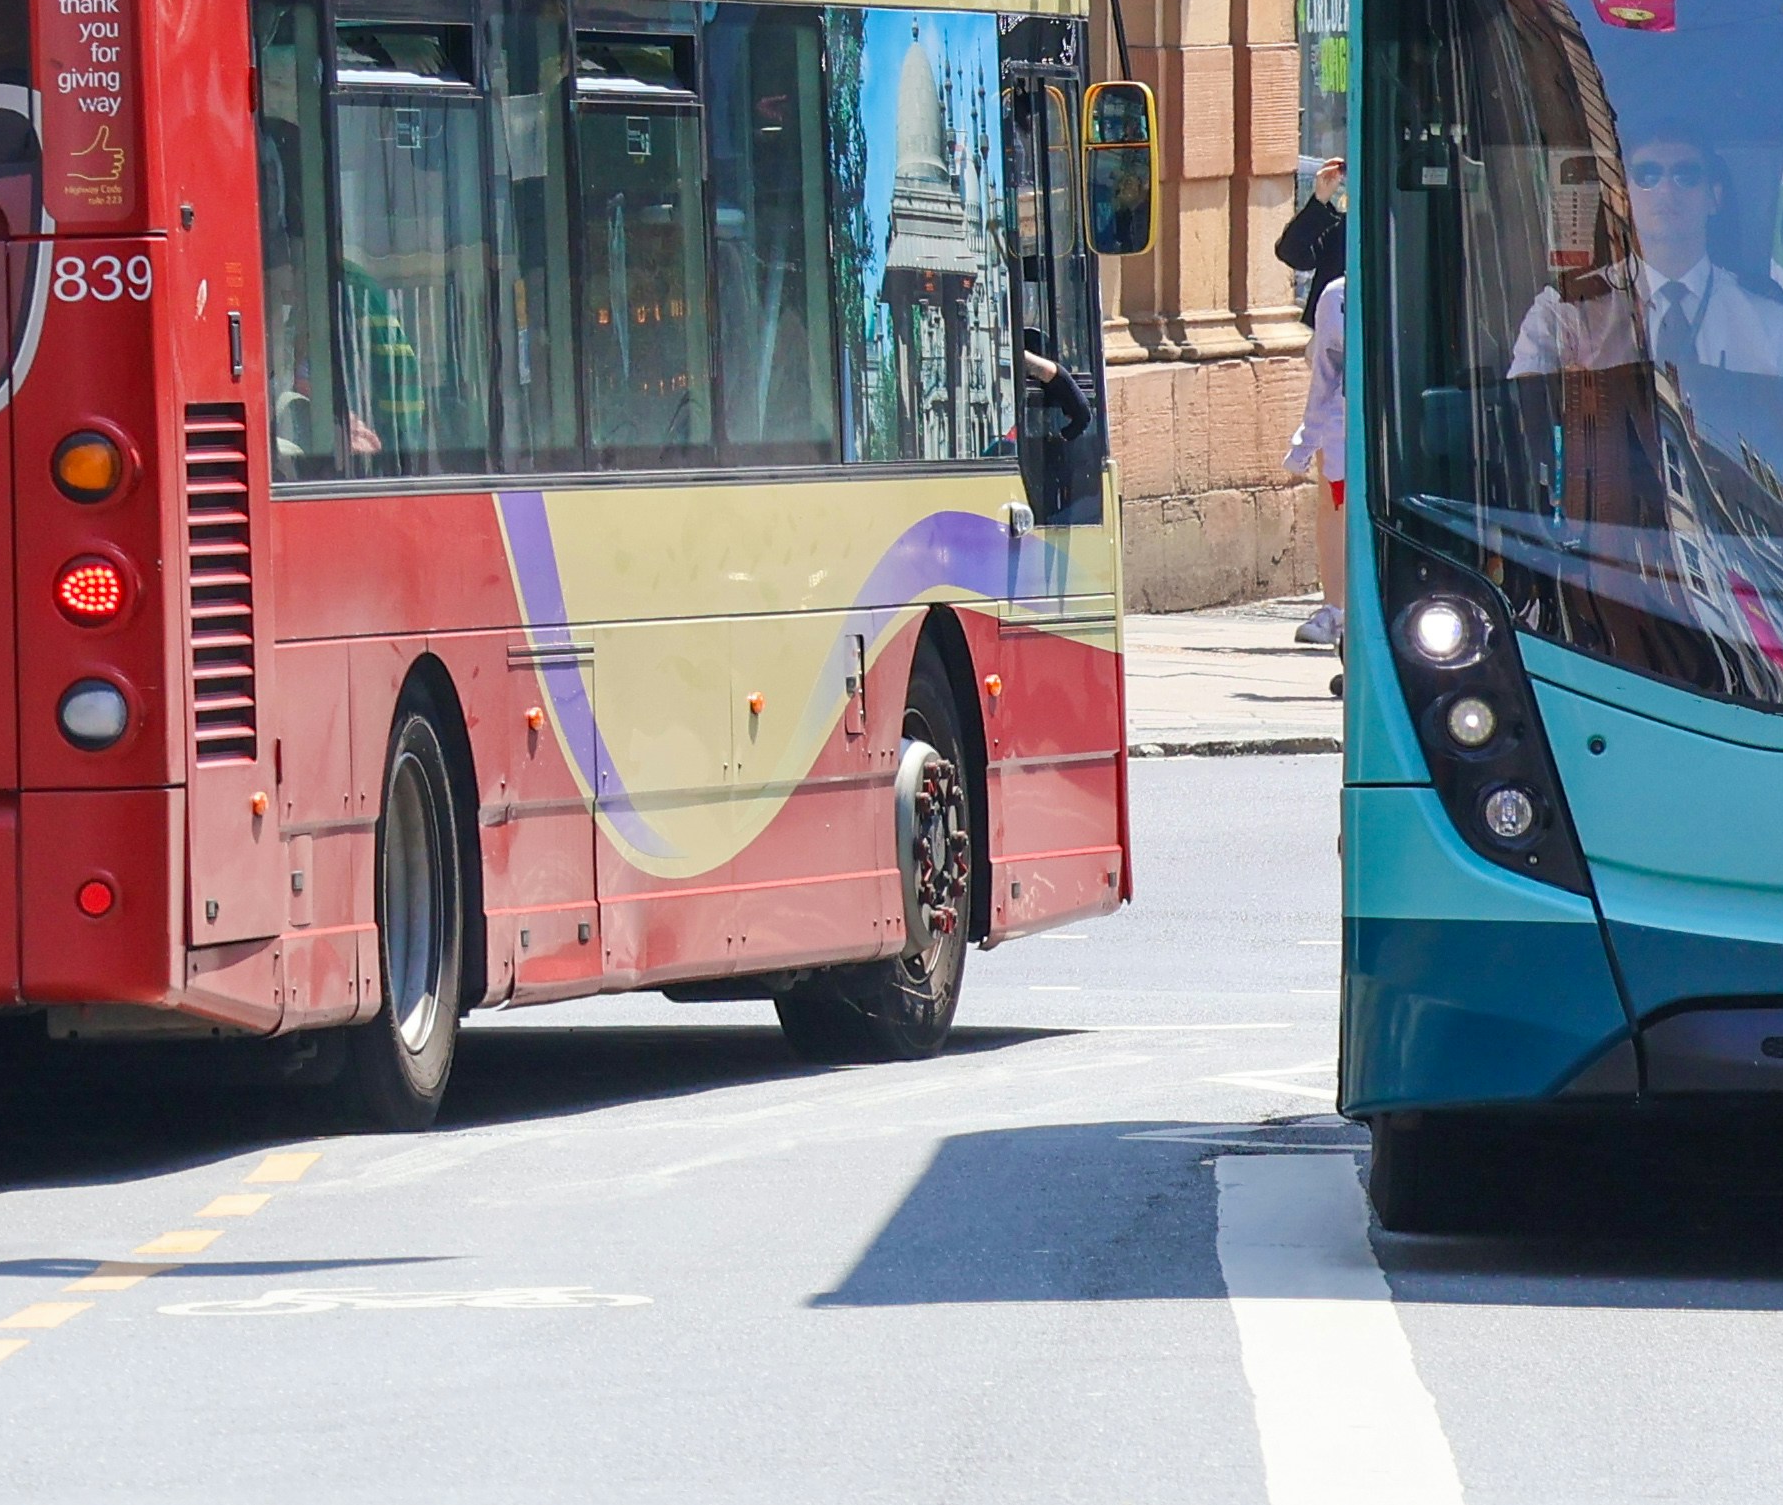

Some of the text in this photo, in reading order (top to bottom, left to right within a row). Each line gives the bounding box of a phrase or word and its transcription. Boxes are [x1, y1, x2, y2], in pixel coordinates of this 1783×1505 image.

[79, 21, 119, 43] you
[90, 43, 120, 63] for
[57, 67, 121, 94] giving
[79, 96, 122, 117] way
[53, 255, 154, 302] 839
